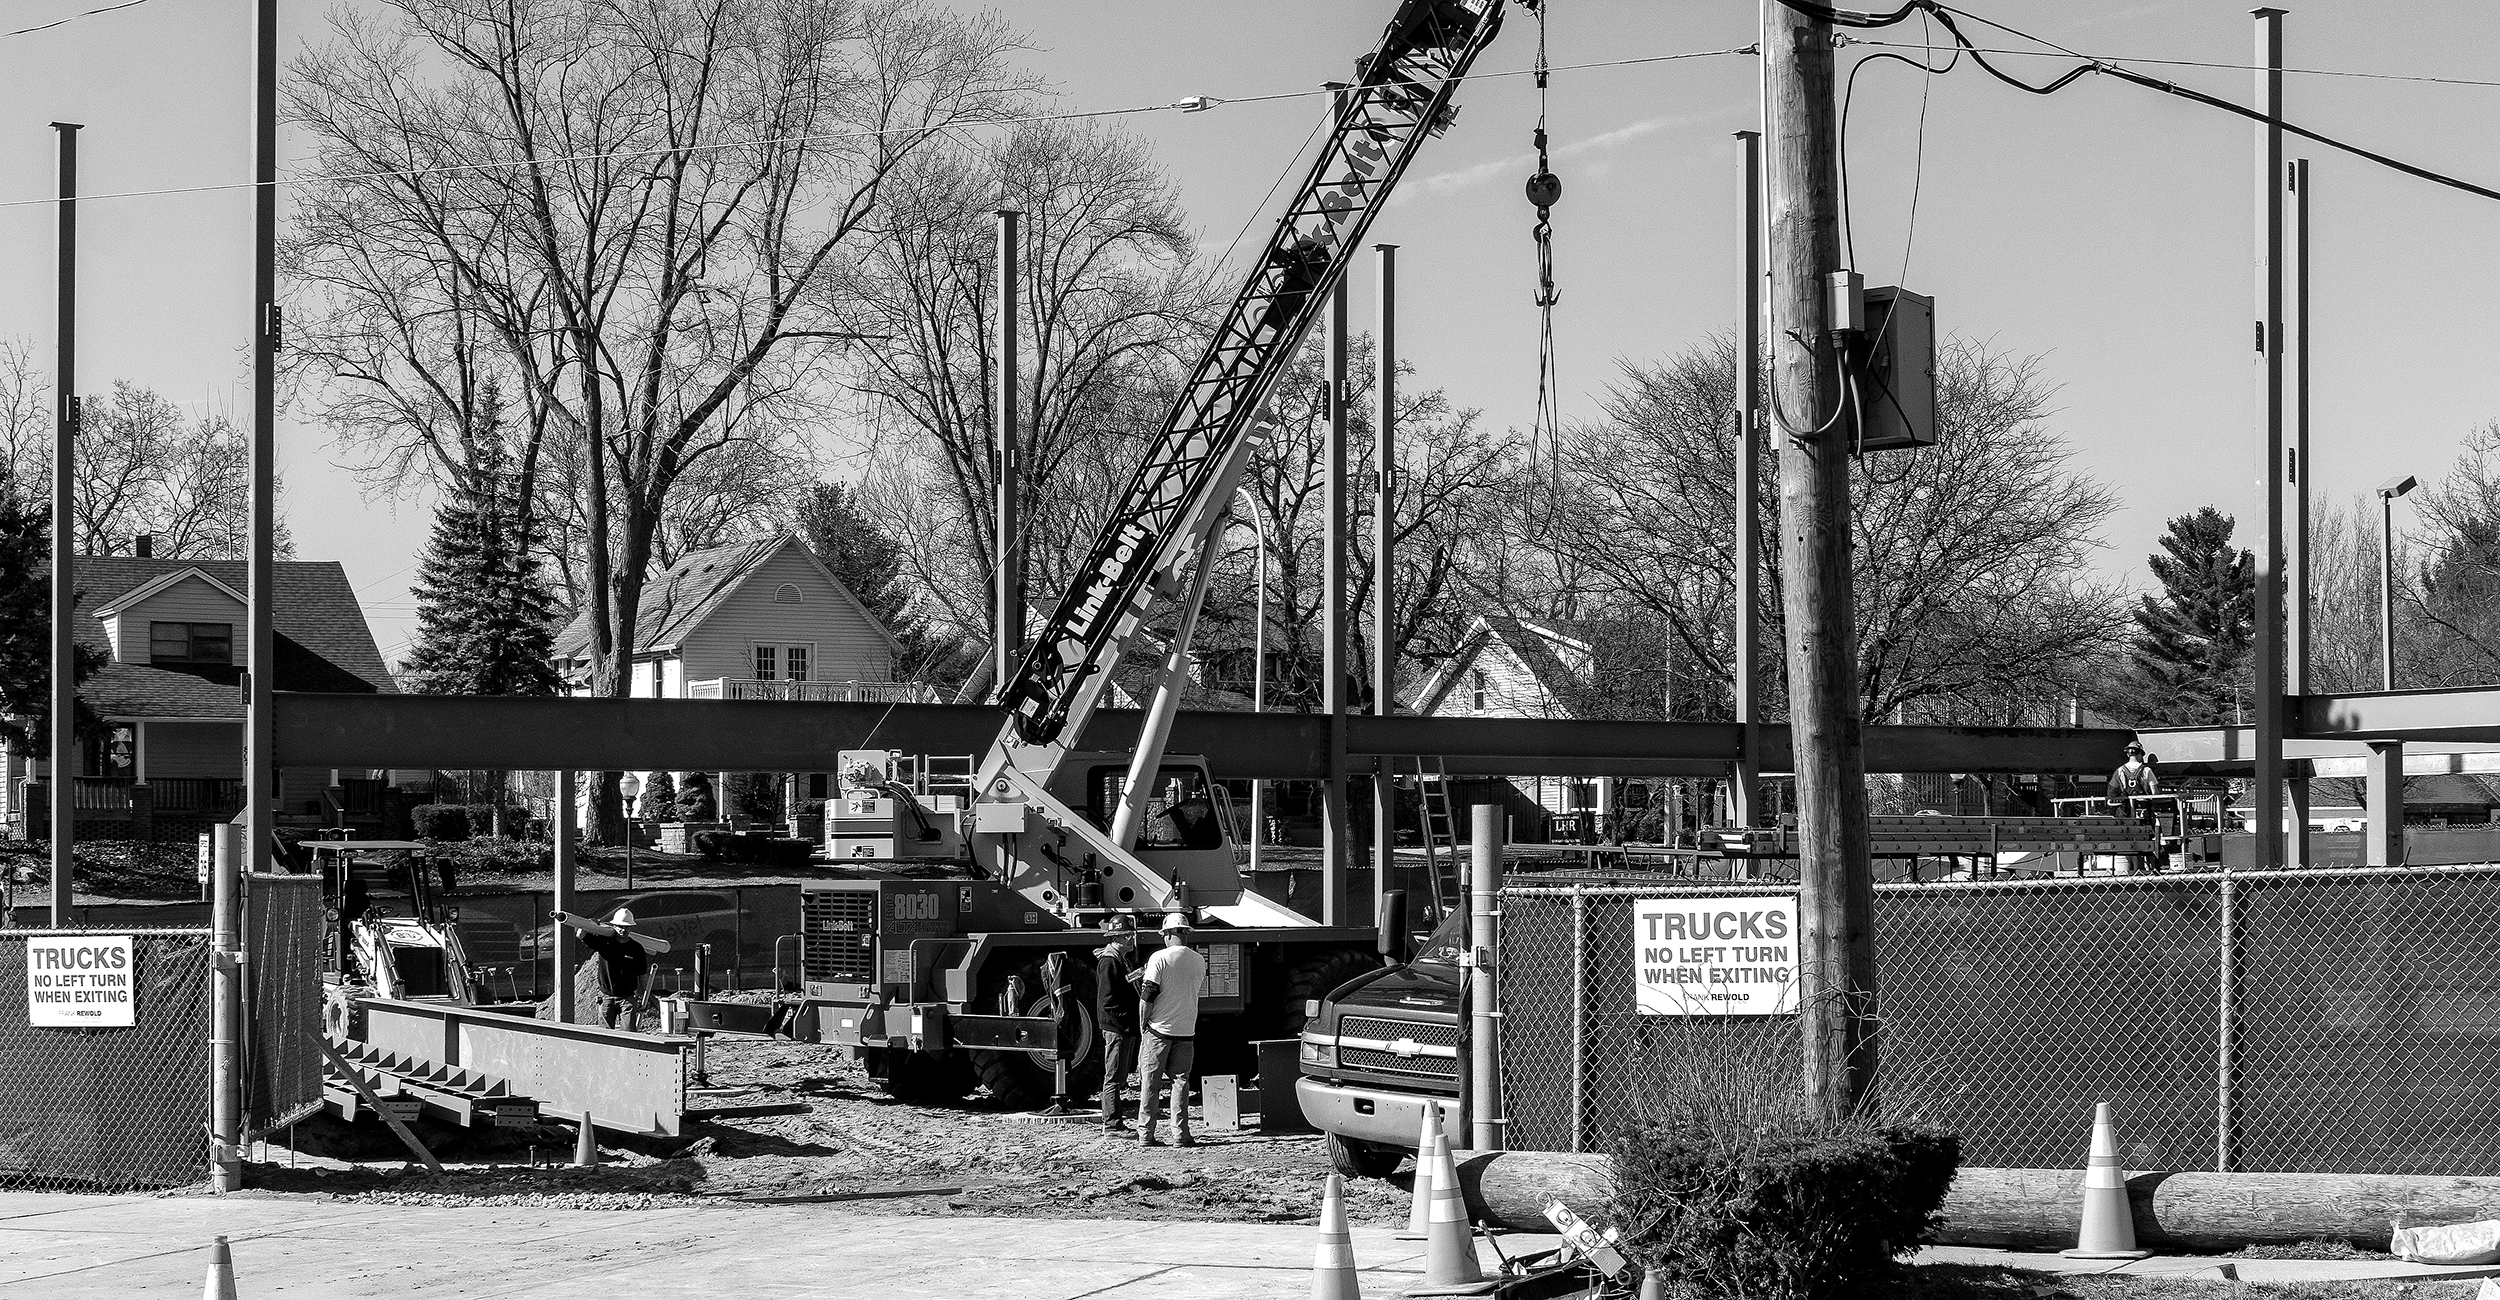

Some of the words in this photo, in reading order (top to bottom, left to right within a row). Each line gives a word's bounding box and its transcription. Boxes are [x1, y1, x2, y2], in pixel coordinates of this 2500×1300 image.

[1065, 523, 1146, 637] Link-Belt
[894, 893, 939, 920] 8030
[1643, 910, 1788, 940] TRUCKS
[33, 946, 126, 969] TRUCKS
[1645, 947, 1673, 963] NO
[1680, 946, 1727, 963] LEFT
[1732, 946, 1788, 962] TURN
[34, 974, 52, 987] NO
[56, 974, 86, 987] LEFT
[89, 973, 126, 987] TURN
[1644, 968, 1703, 984] WHEN
[1709, 966, 1789, 983] EXITING
[34, 990, 71, 1003] WHEN
[75, 989, 128, 1003] EXITING
[1711, 993, 1750, 1001] REWOLD
